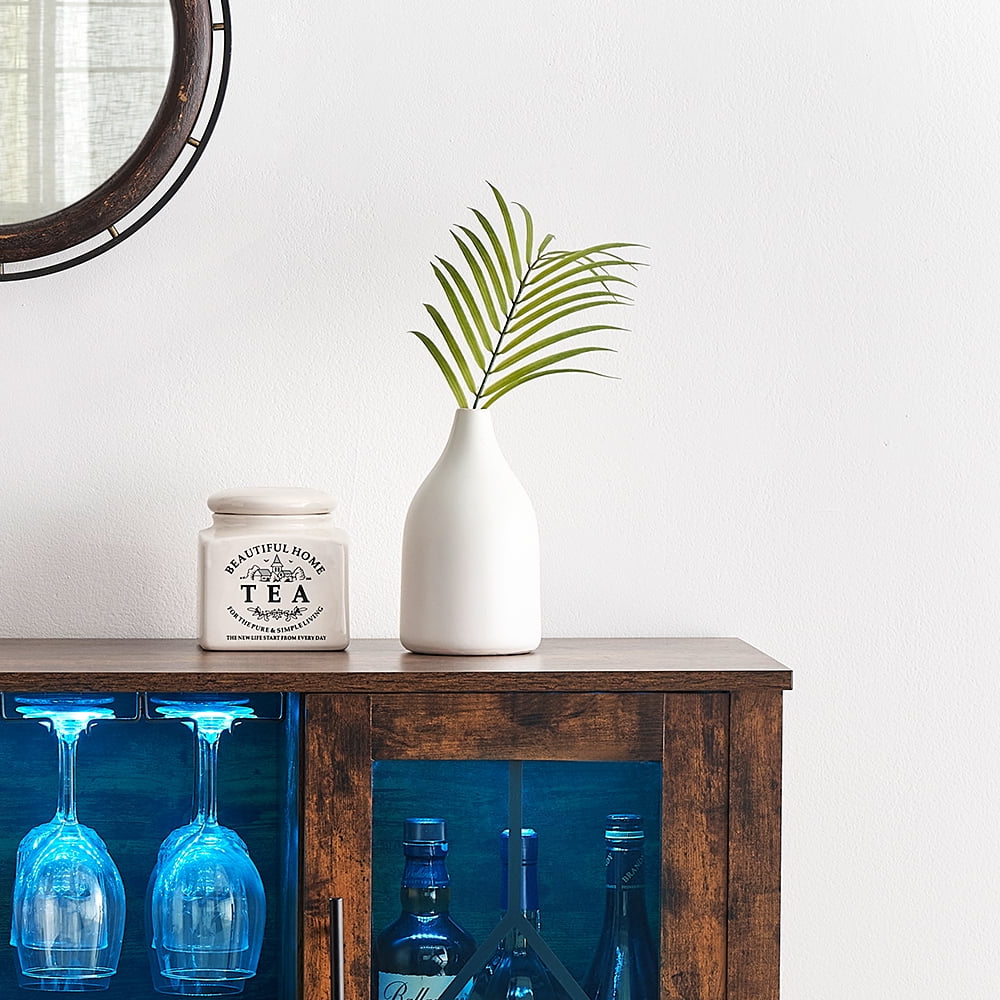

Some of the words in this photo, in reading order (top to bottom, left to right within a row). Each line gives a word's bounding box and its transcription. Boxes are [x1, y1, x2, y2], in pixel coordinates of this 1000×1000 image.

[225, 543, 289, 574] BEAUTIFUL
[291, 546, 326, 575] HOME
[240, 584, 310, 603] TEA
[227, 606, 239, 619] FOR
[238, 617, 251, 628] THE
[250, 622, 269, 633] PURE
[276, 622, 304, 633] SIMPLE
[302, 605, 324, 626] LIVING
